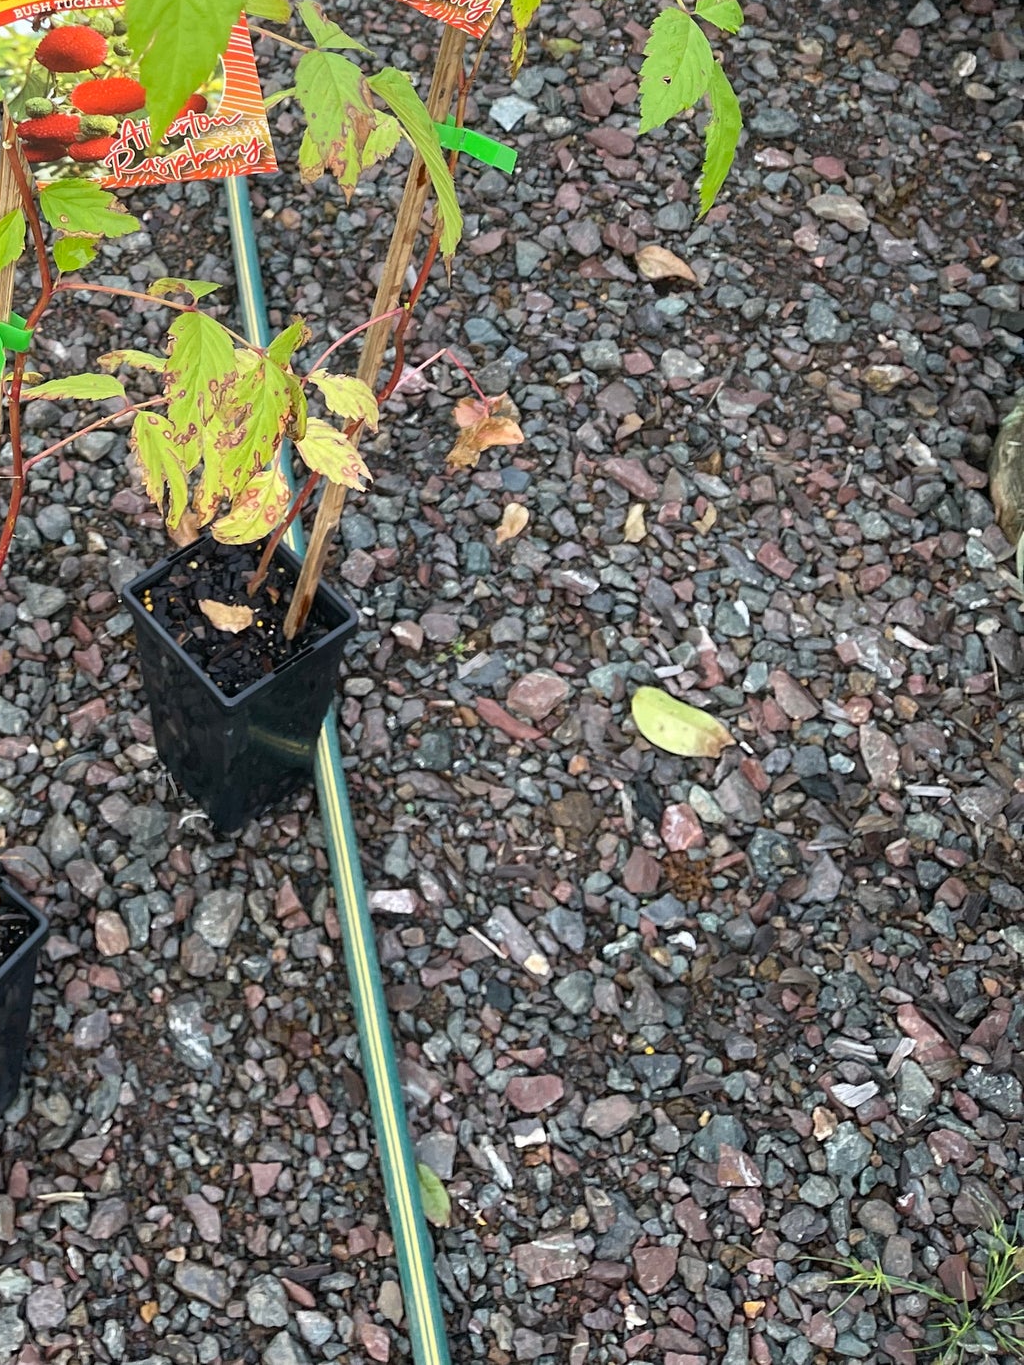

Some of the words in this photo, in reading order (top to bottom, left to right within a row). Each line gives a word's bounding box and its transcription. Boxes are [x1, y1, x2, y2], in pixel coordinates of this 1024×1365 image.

[13, 2, 52, 19] BUSH
[110, 110, 243, 152] Aterton
[104, 136, 266, 181] Raspberry
